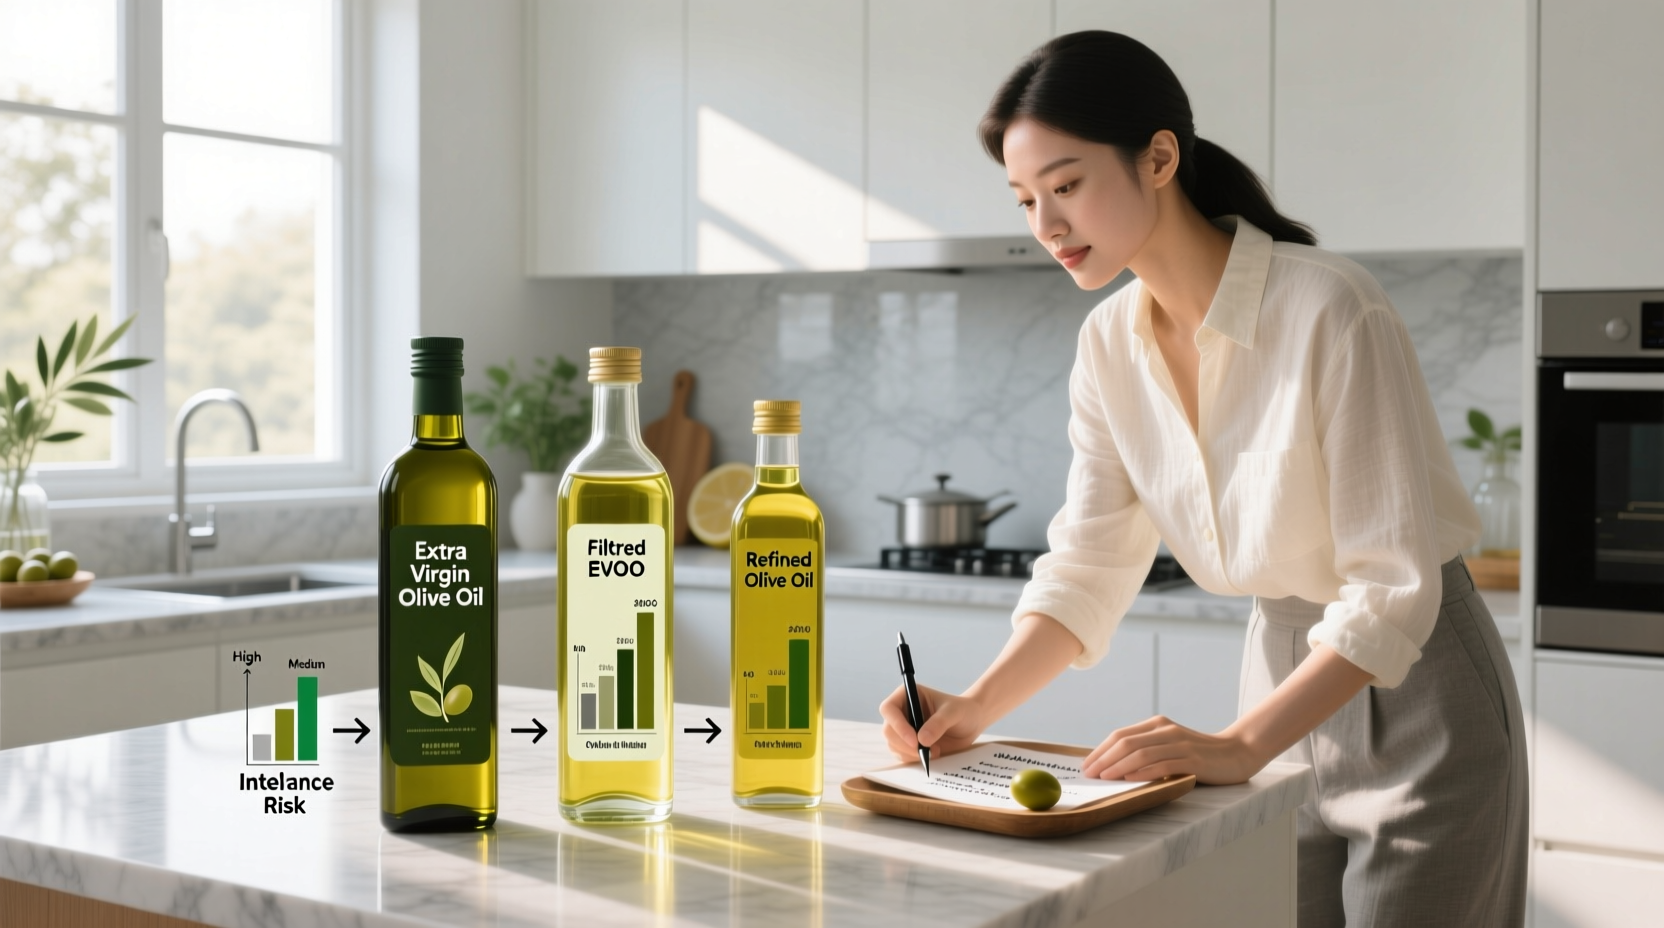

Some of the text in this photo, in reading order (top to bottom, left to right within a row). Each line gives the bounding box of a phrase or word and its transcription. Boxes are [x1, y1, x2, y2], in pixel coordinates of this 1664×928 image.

[415, 541, 467, 560] Extra
[588, 538, 645, 556] Filtred
[746, 551, 812, 567] Refined
[409, 564, 470, 588] Virgin
[588, 560, 645, 577] EVOO
[744, 571, 814, 588] Olive Oil
[398, 586, 483, 607] Olive Oil
